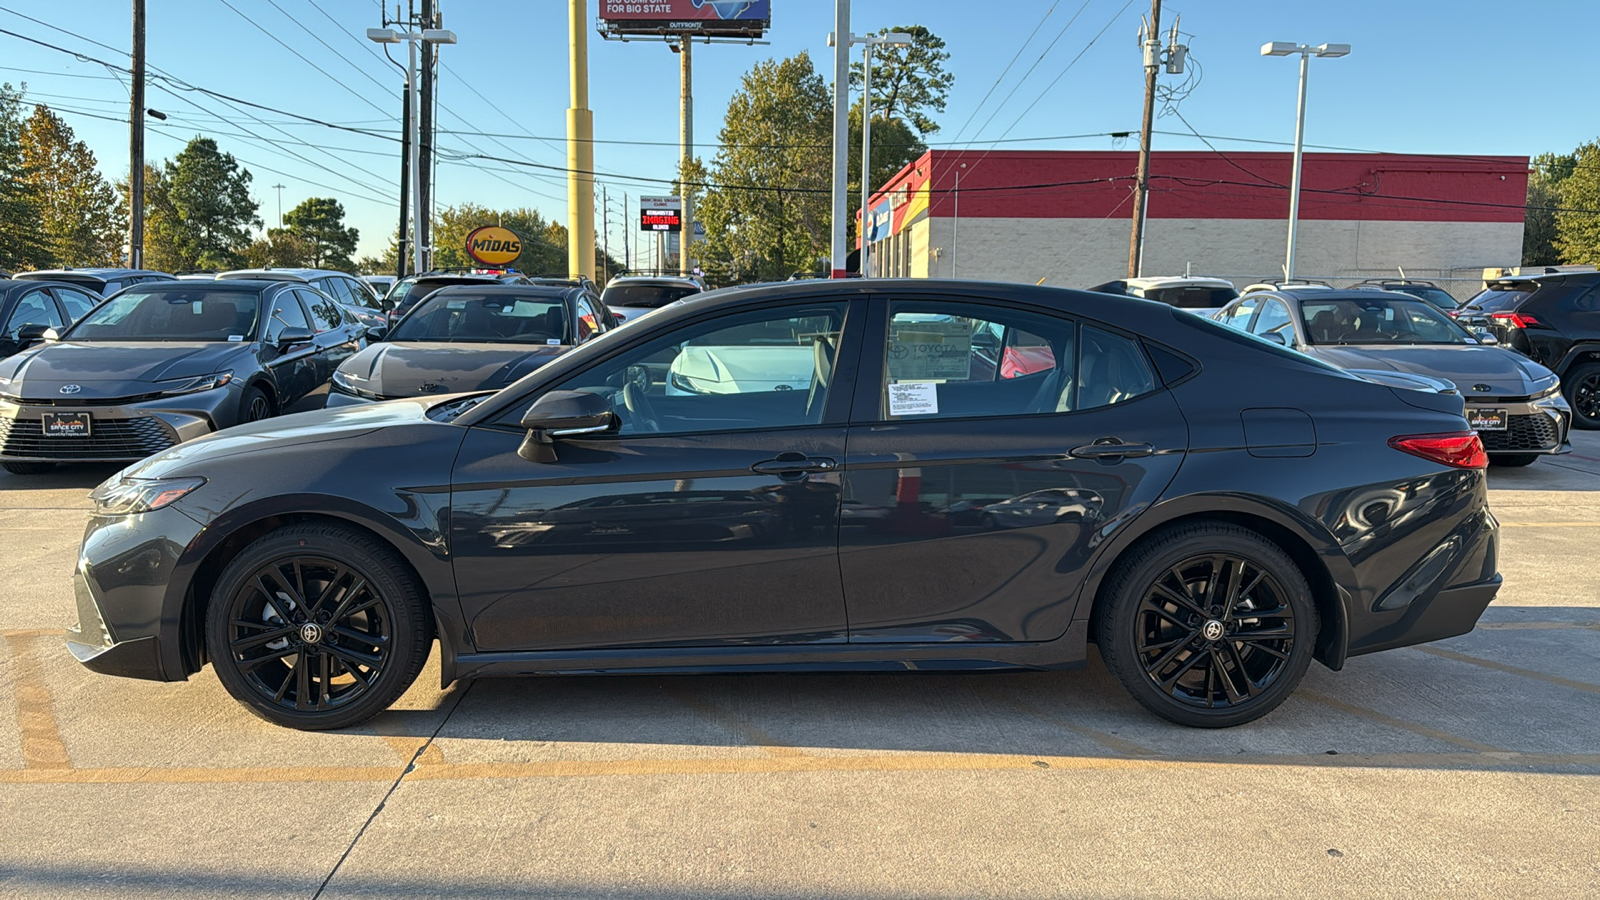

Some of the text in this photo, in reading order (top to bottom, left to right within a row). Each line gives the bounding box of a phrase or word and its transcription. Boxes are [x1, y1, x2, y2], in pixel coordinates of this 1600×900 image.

[607, 5, 671, 13] FOR BIG STATE
[642, 216, 679, 225] IMAGING
[473, 238, 520, 253] MIDAS
[911, 344, 958, 353] TOYOTA
